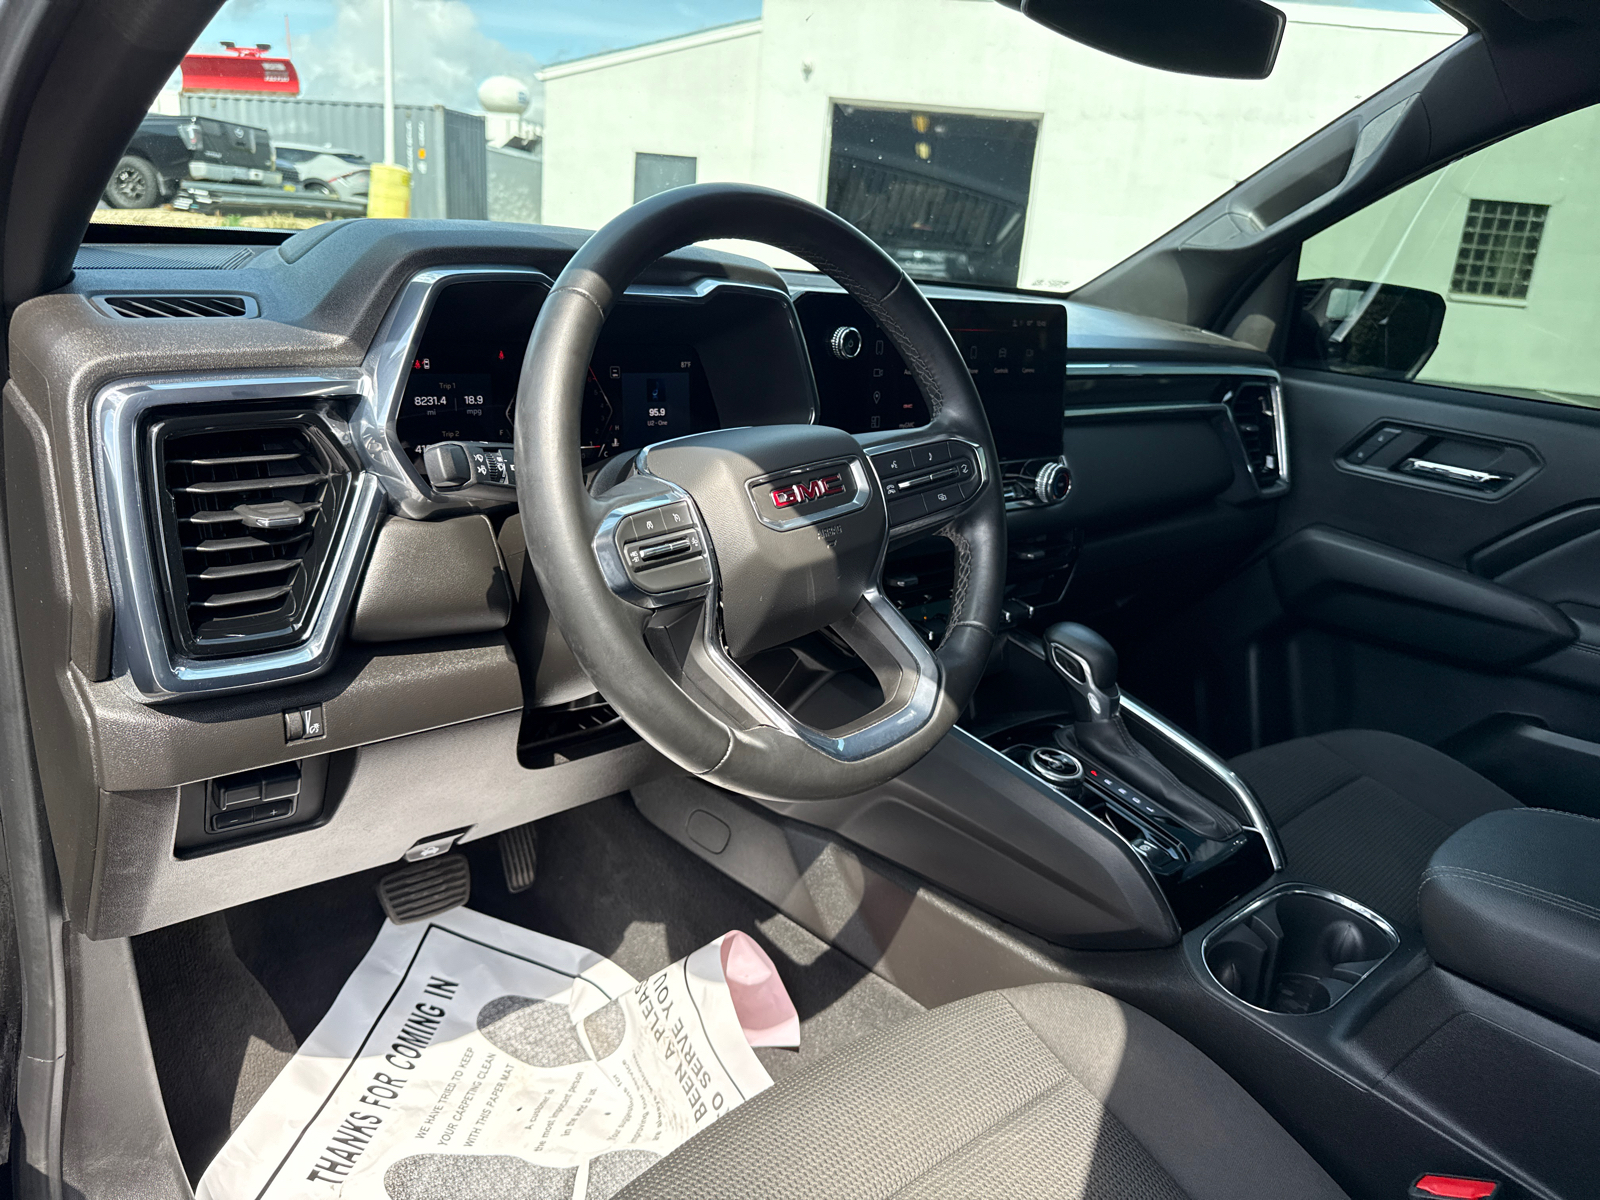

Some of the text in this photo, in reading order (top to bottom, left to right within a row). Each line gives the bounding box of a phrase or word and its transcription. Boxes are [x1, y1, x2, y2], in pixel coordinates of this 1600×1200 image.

[439, 382, 452, 390] Trip
[414, 396, 447, 406] 8231.4
[426, 408, 437, 416] mi
[464, 395, 484, 405] 18.9
[466, 408, 482, 416] mpg
[648, 408, 666, 416] 95.9
[442, 430, 455, 438] Trip
[770, 474, 846, 508] GMC
[653, 972, 673, 1020] YOU
[665, 1039, 676, 1060] A
[671, 1017, 711, 1089] SERVE
[306, 975, 459, 1184] THANKS FOR COMING IN
[415, 1046, 475, 1139] WE HAVE TRIED TO KEEP
[613, 1074, 622, 1087] for
[674, 1062, 708, 1123] BEEN
[437, 1052, 497, 1146] YOUR CARPETING CLEAN
[463, 1063, 515, 1147] WITH THIS PAPER MAT
[534, 1140, 546, 1152] the
[541, 1119, 556, 1138] most
[568, 1071, 584, 1093] person
